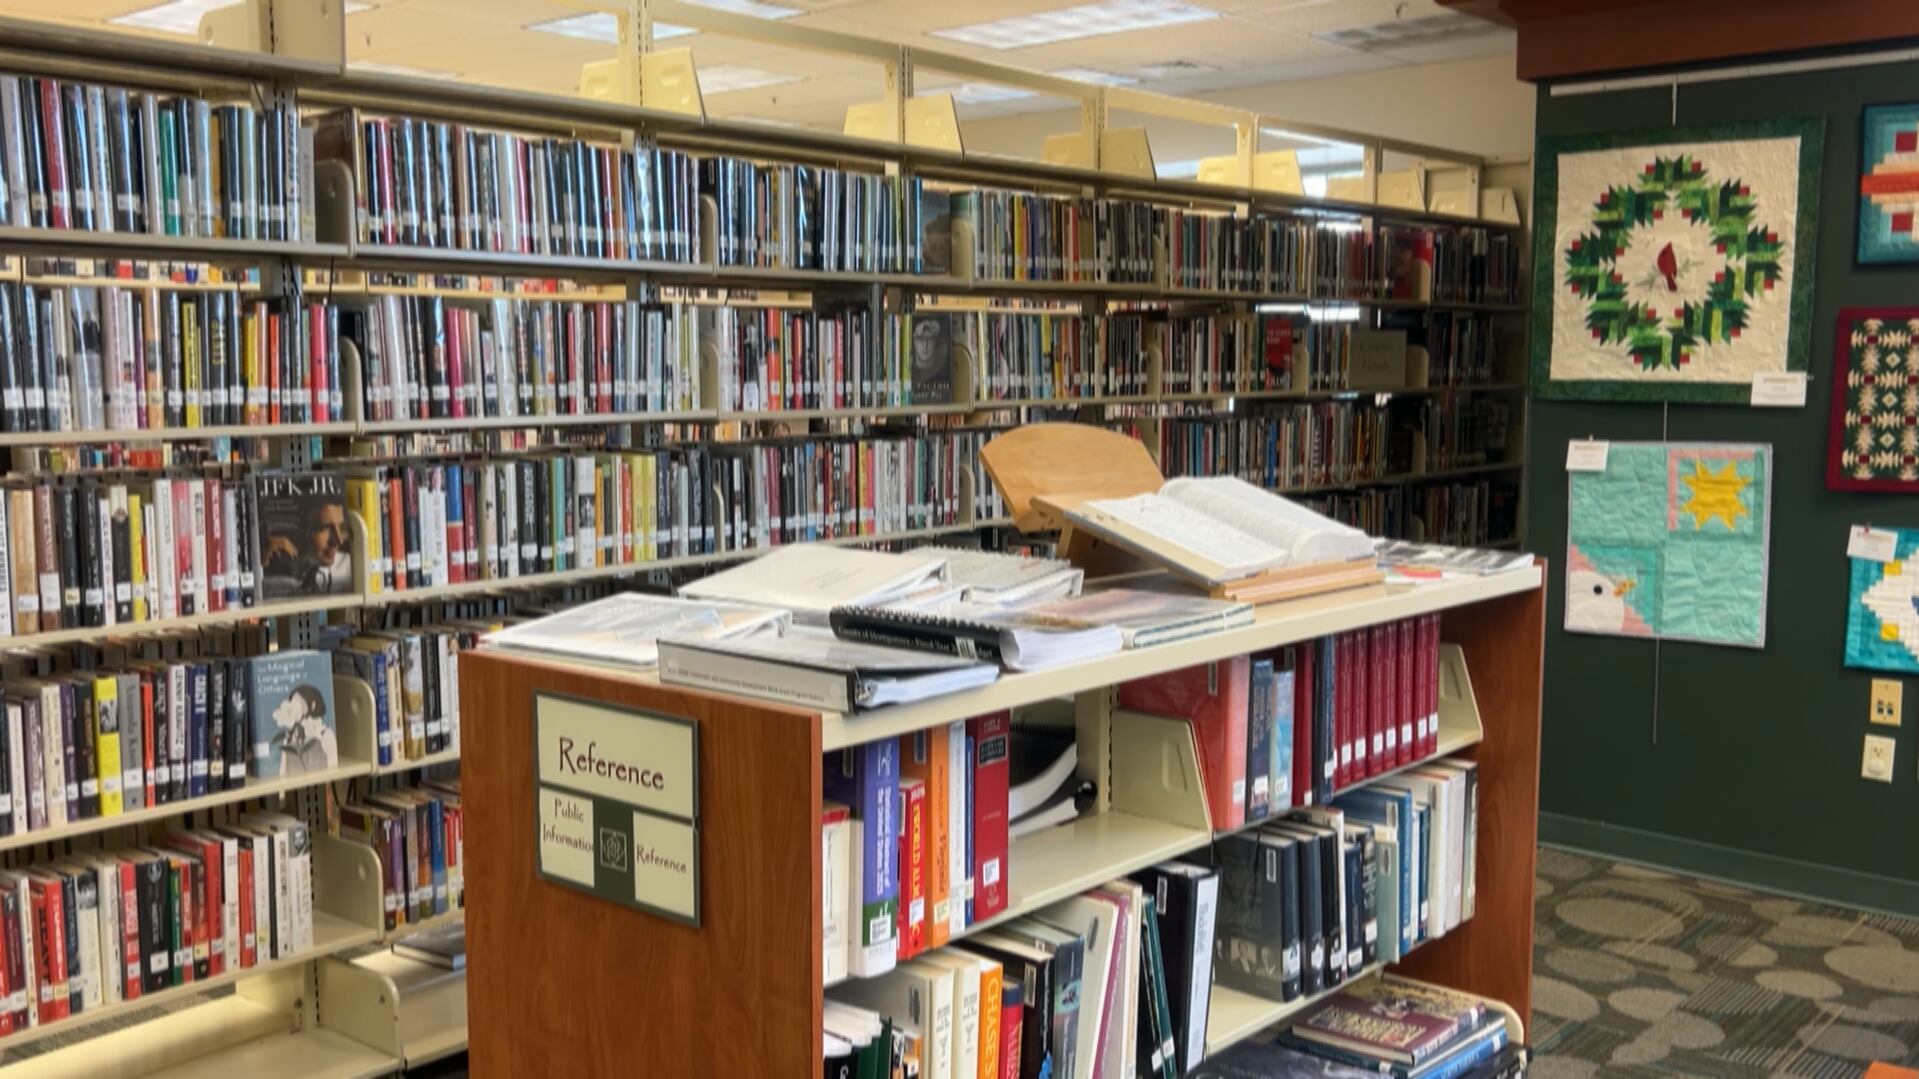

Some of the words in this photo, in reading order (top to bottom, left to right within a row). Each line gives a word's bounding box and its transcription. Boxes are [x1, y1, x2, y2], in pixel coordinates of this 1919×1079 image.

[260, 477, 303, 497] JFK
[309, 476, 341, 495] JR.
[257, 671, 300, 685] Language
[267, 658, 304, 673] Magical
[175, 670, 184, 703] LENNY
[257, 684, 289, 696] Others
[559, 735, 664, 792] Reference
[554, 798, 584, 824] Public
[911, 811, 921, 865] WORLD
[636, 844, 687, 875] Reference
[938, 832, 947, 895] Virginia
